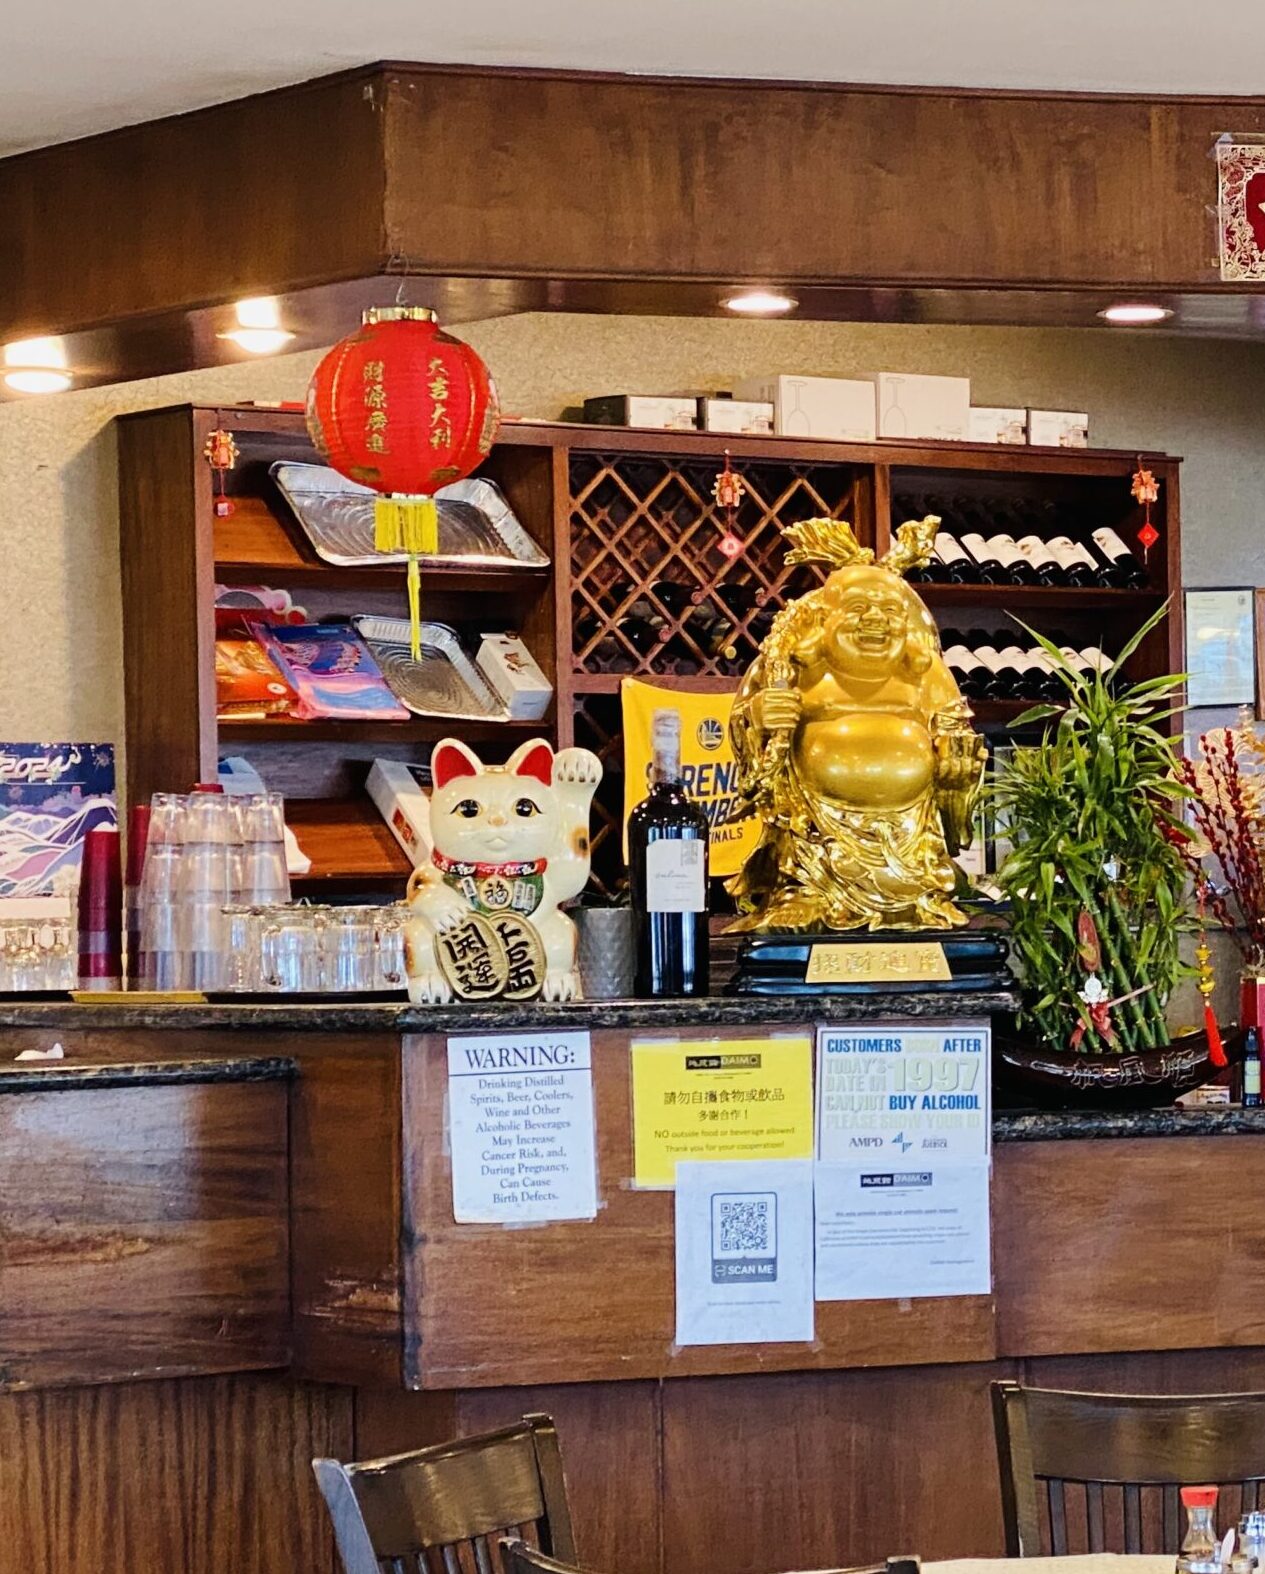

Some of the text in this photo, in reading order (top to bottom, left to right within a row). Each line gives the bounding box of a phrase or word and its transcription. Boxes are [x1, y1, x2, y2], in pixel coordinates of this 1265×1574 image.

[426, 357, 452, 450] 大吉大利
[709, 827, 744, 844] INALS
[827, 1038, 902, 1053] CUSTOMERS
[943, 1038, 982, 1053] AFTER
[465, 1045, 575, 1069] WARNING:
[890, 1058, 980, 1092] 1997
[478, 1075, 564, 1090] Drinking Distilled
[470, 1090, 573, 1105] Spirits, Beer, Coolers,
[889, 1095, 917, 1110] BUY
[921, 1094, 981, 1110] ALCOHOL
[485, 1104, 561, 1117] Wine and Other
[475, 1119, 571, 1133] Alcoholic Beverages
[654, 1130, 669, 1139] NO
[671, 1129, 699, 1138] outside
[701, 1129, 718, 1137] food
[729, 1128, 764, 1138] beverage
[766, 1127, 795, 1135] allowed
[492, 1134, 555, 1147] May Increase
[481, 1150, 515, 1161] Cancer
[519, 1148, 544, 1160] Risk,
[690, 1145, 703, 1153] you
[481, 1162, 569, 1176] During Pregnancy,
[500, 1177, 551, 1189] Can Cause
[493, 1191, 559, 1204] Birth Defects.
[728, 1264, 774, 1275] SCAN ME
